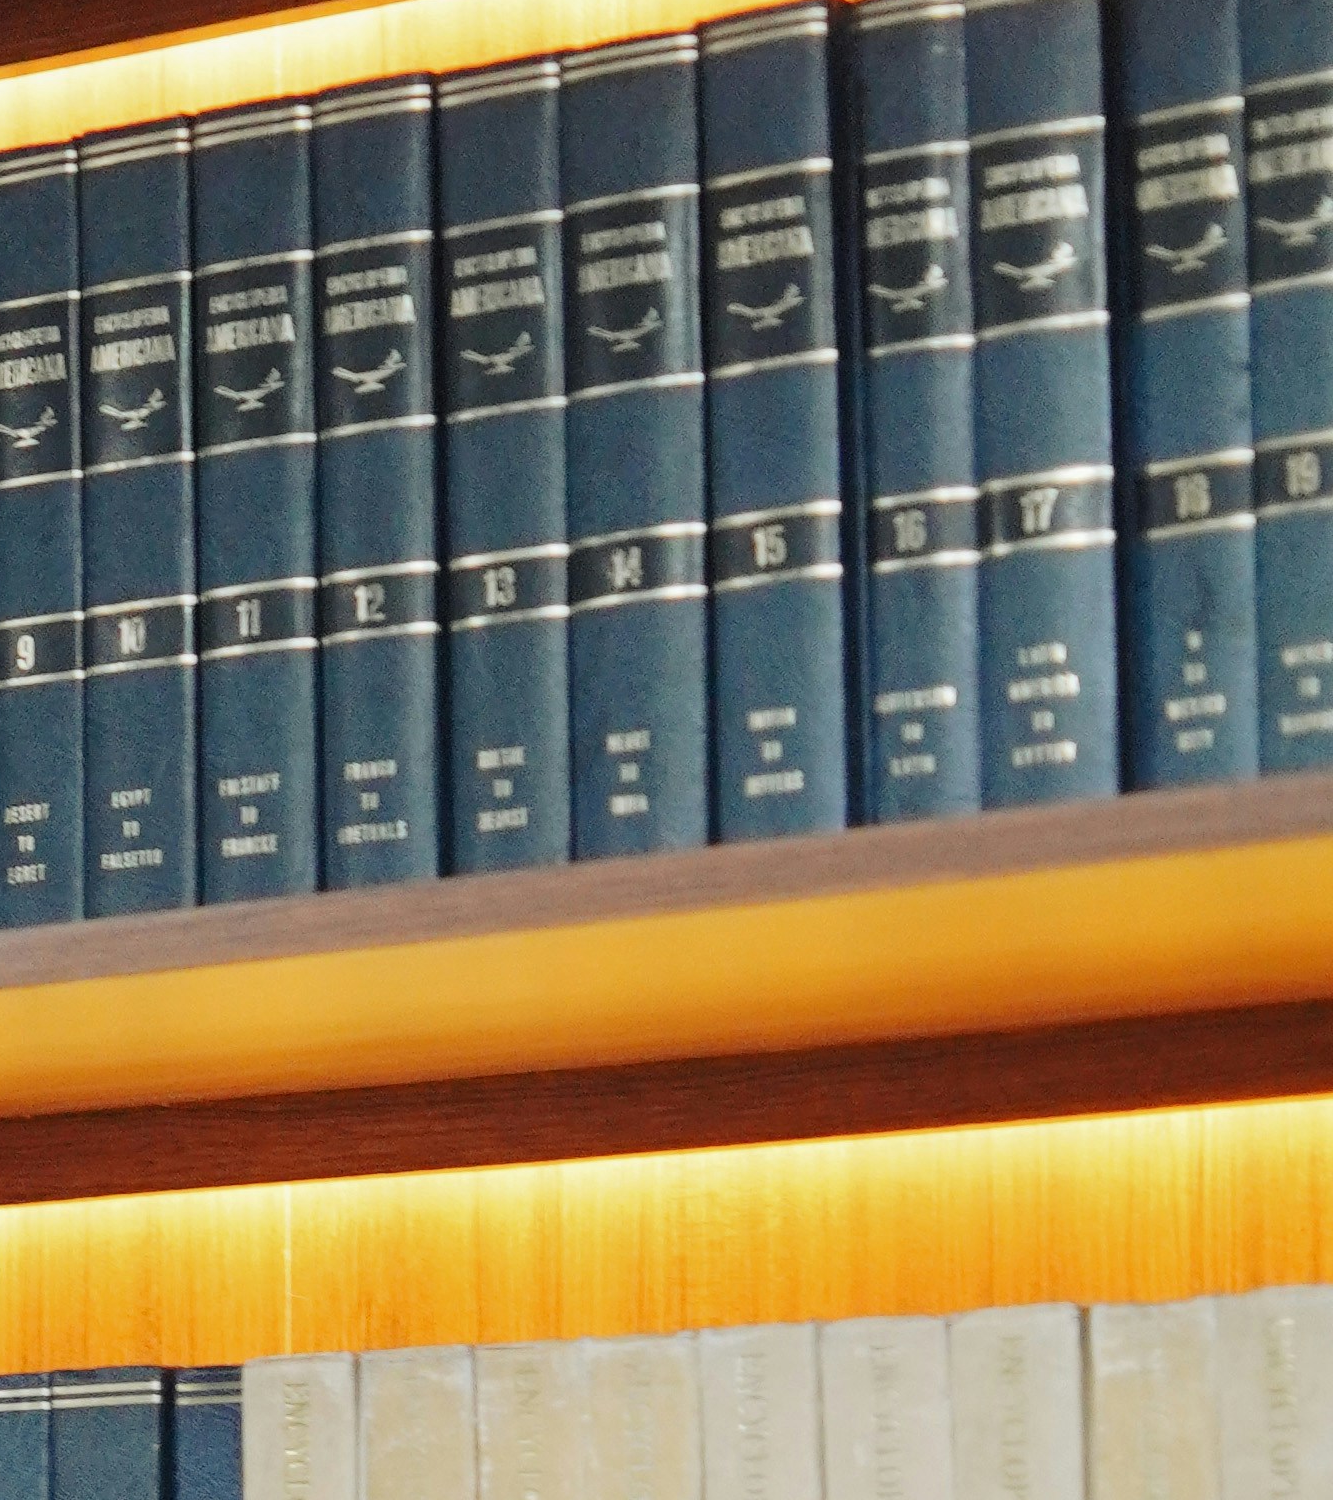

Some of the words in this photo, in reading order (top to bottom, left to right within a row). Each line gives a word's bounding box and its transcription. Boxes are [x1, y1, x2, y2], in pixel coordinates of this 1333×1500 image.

[1020, 488, 1058, 533] 17
[754, 524, 787, 567] 15
[354, 583, 385, 620] 12
[484, 566, 516, 607] 13
[236, 599, 261, 637] 11
[17, 634, 35, 670] 9
